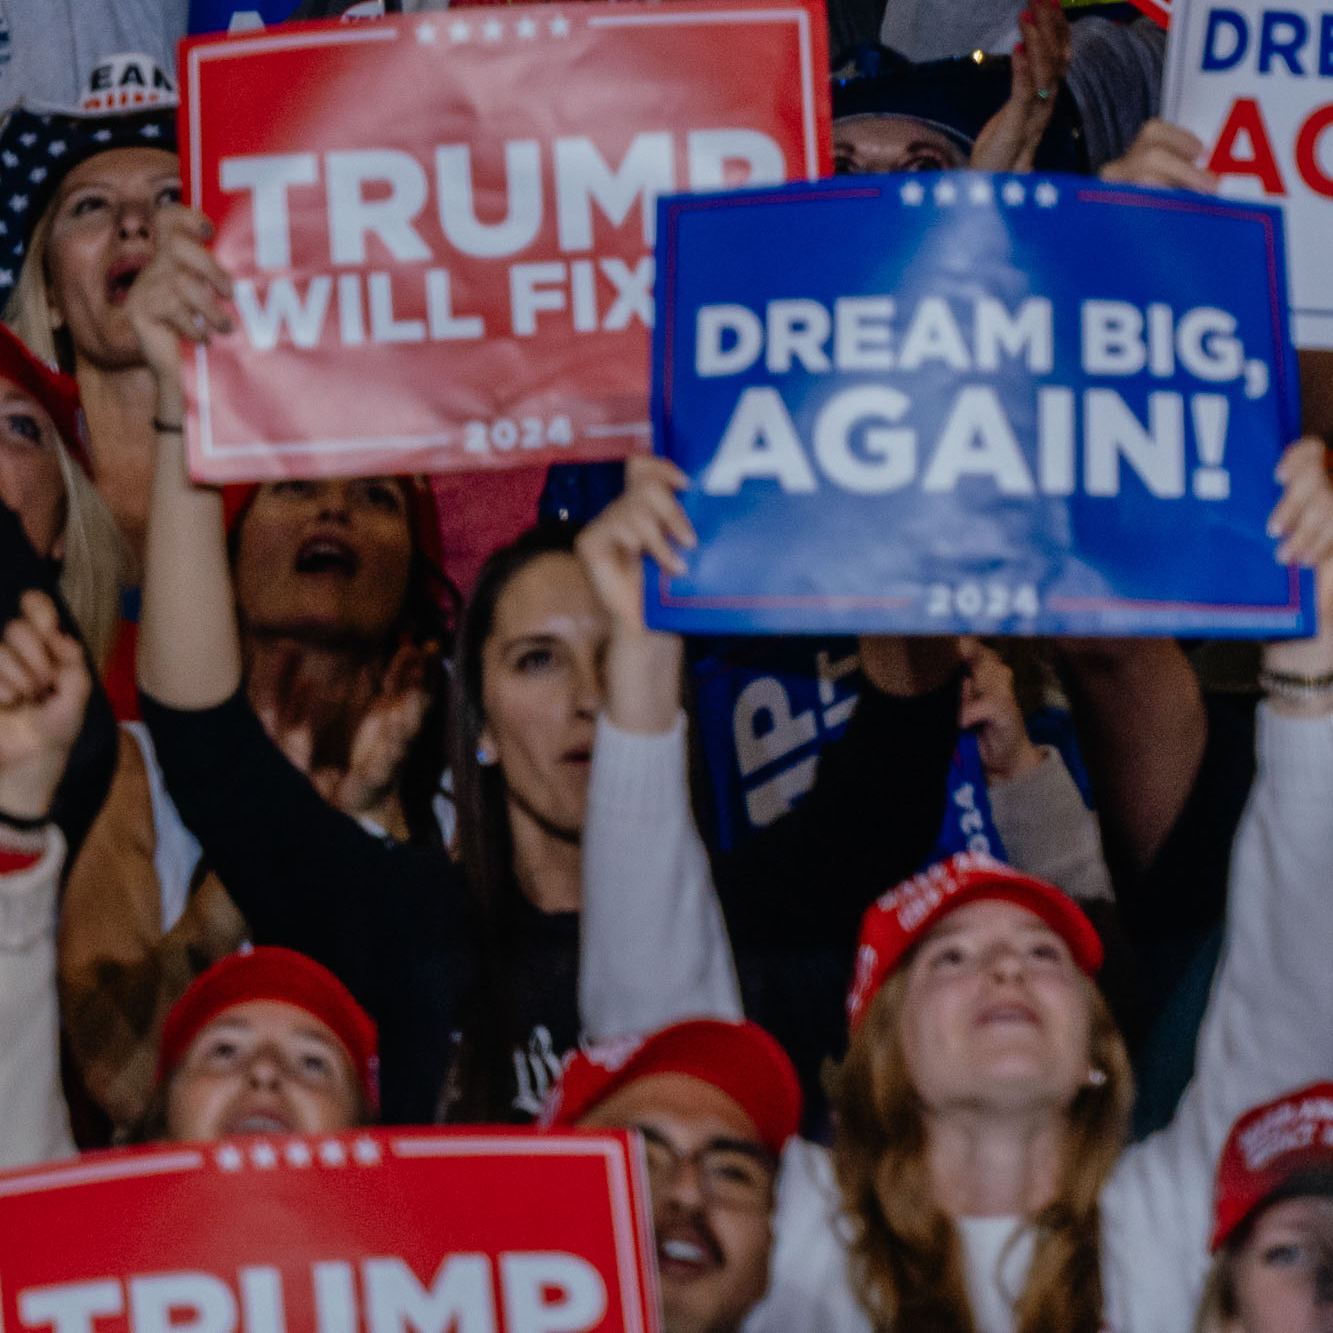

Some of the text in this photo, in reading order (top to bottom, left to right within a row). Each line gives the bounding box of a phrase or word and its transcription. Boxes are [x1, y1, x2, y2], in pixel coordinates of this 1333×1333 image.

[233, 260, 656, 354] WILL FIX
[695, 295, 1271, 400] DREAM BIG,
[462, 414, 575, 456] 2024
[703, 384, 1231, 501] AGAIN!
[927, 583, 1039, 619] 2024
